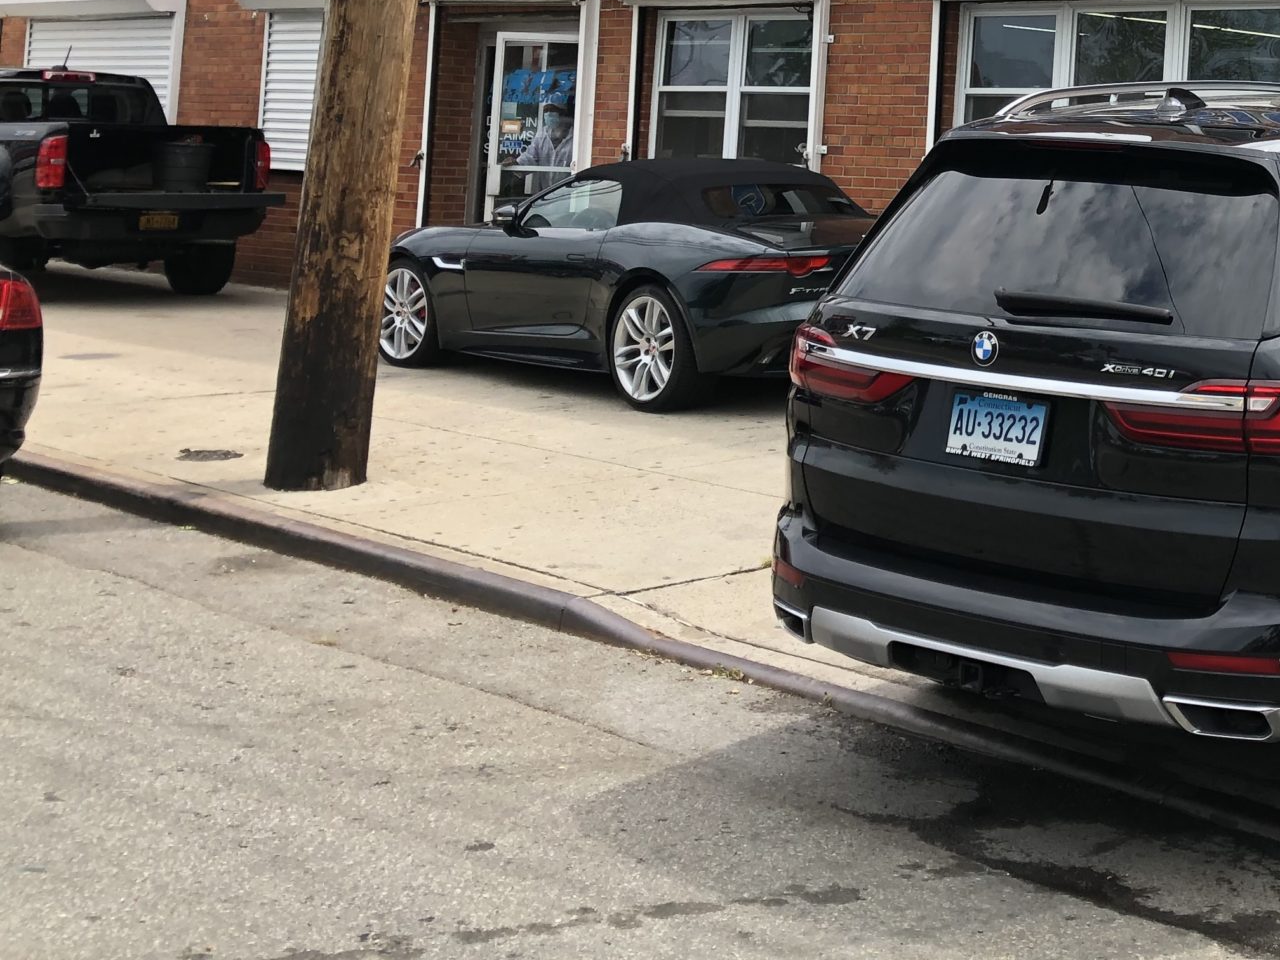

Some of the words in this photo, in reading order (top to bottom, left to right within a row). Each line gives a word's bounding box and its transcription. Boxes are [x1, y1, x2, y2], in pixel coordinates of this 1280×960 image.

[841, 324, 877, 340] X7
[983, 391, 1018, 401] GENGRAS
[978, 400, 1021, 411] Connecticut
[968, 442, 1003, 453] Constitution
[1003, 447, 1017, 455] State
[945, 447, 962, 455] BMW
[971, 450, 989, 459] WEST
[990, 452, 1035, 467] SPRINGFIELD
